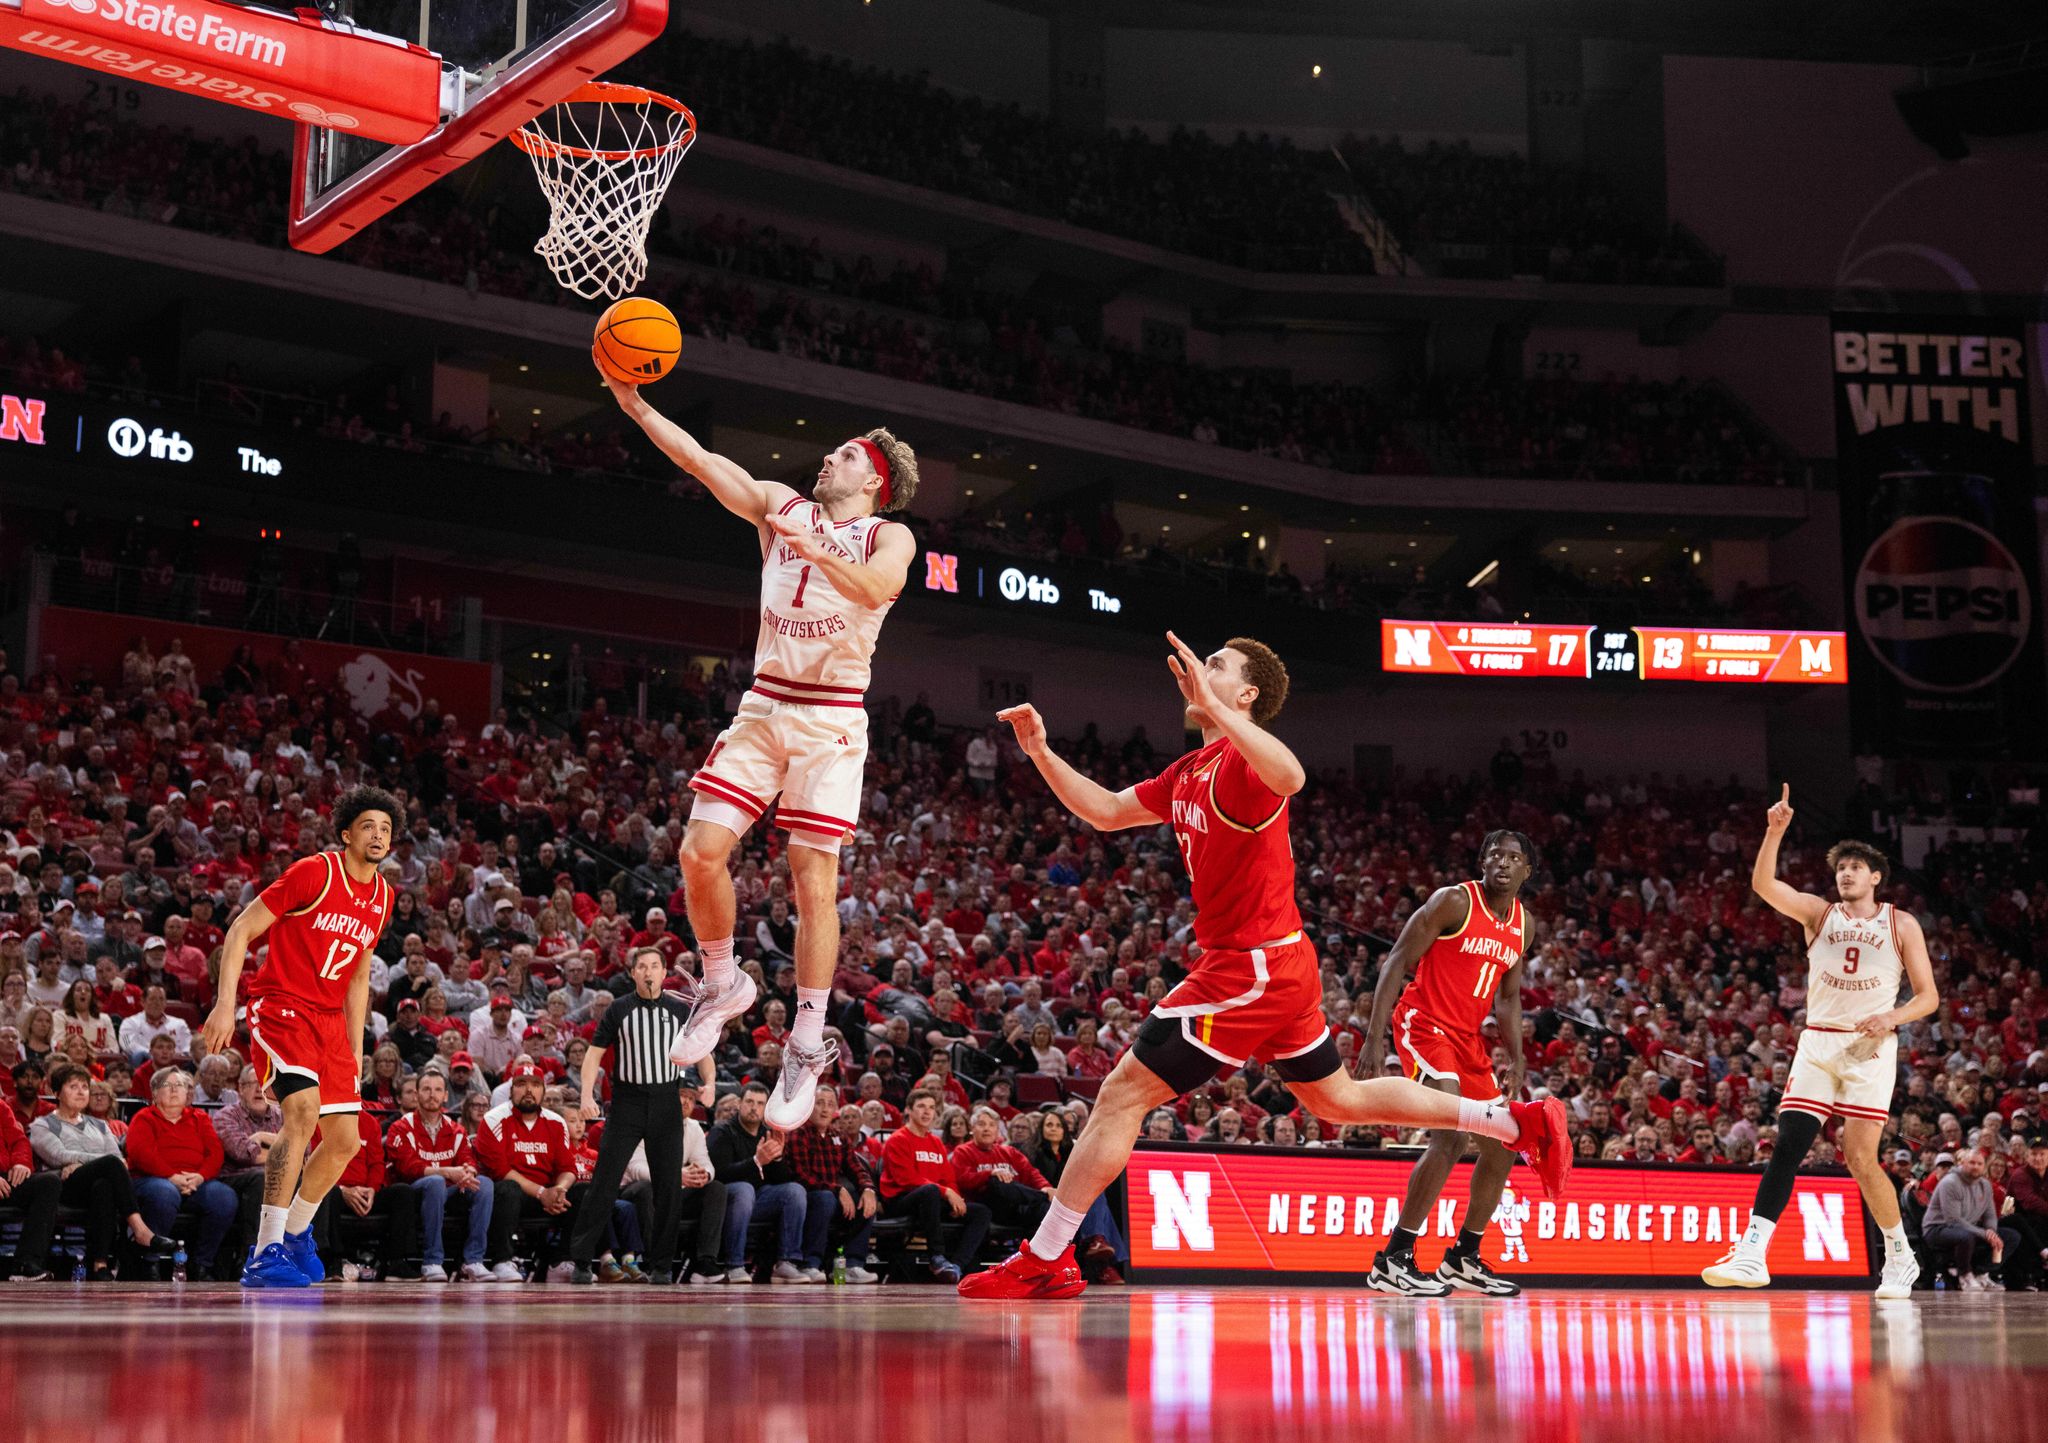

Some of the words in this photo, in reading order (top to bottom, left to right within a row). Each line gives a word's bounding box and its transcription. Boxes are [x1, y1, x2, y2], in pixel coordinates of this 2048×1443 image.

[1536, 352, 1580, 369] 222
[1833, 331, 2024, 378] BETTER
[1845, 382, 2020, 444] WITH
[0, 394, 46, 445] N
[238, 447, 282, 476] The
[792, 565, 811, 608] 1
[925, 551, 959, 593] N
[1089, 589, 1121, 613] The
[1866, 584, 2019, 622] PEPSI
[1394, 628, 1431, 666] N
[1548, 635, 1578, 666] 17
[1652, 637, 1684, 669] 13
[1800, 639, 1832, 672] M
[983, 680, 1027, 702] 119
[1519, 729, 1567, 749] 120
[1827, 930, 1885, 950] NEBRASKA
[319, 938, 358, 981] 12
[1843, 946, 1860, 975] 9
[1472, 961, 1497, 999] 11
[1821, 970, 1882, 991] CORNHUSKERS
[1148, 1170, 1215, 1250] N
[1268, 1194, 1457, 1237] NEBRAK
[1537, 1202, 1753, 1243] BASKETBAL
[1797, 1192, 1850, 1262] N
